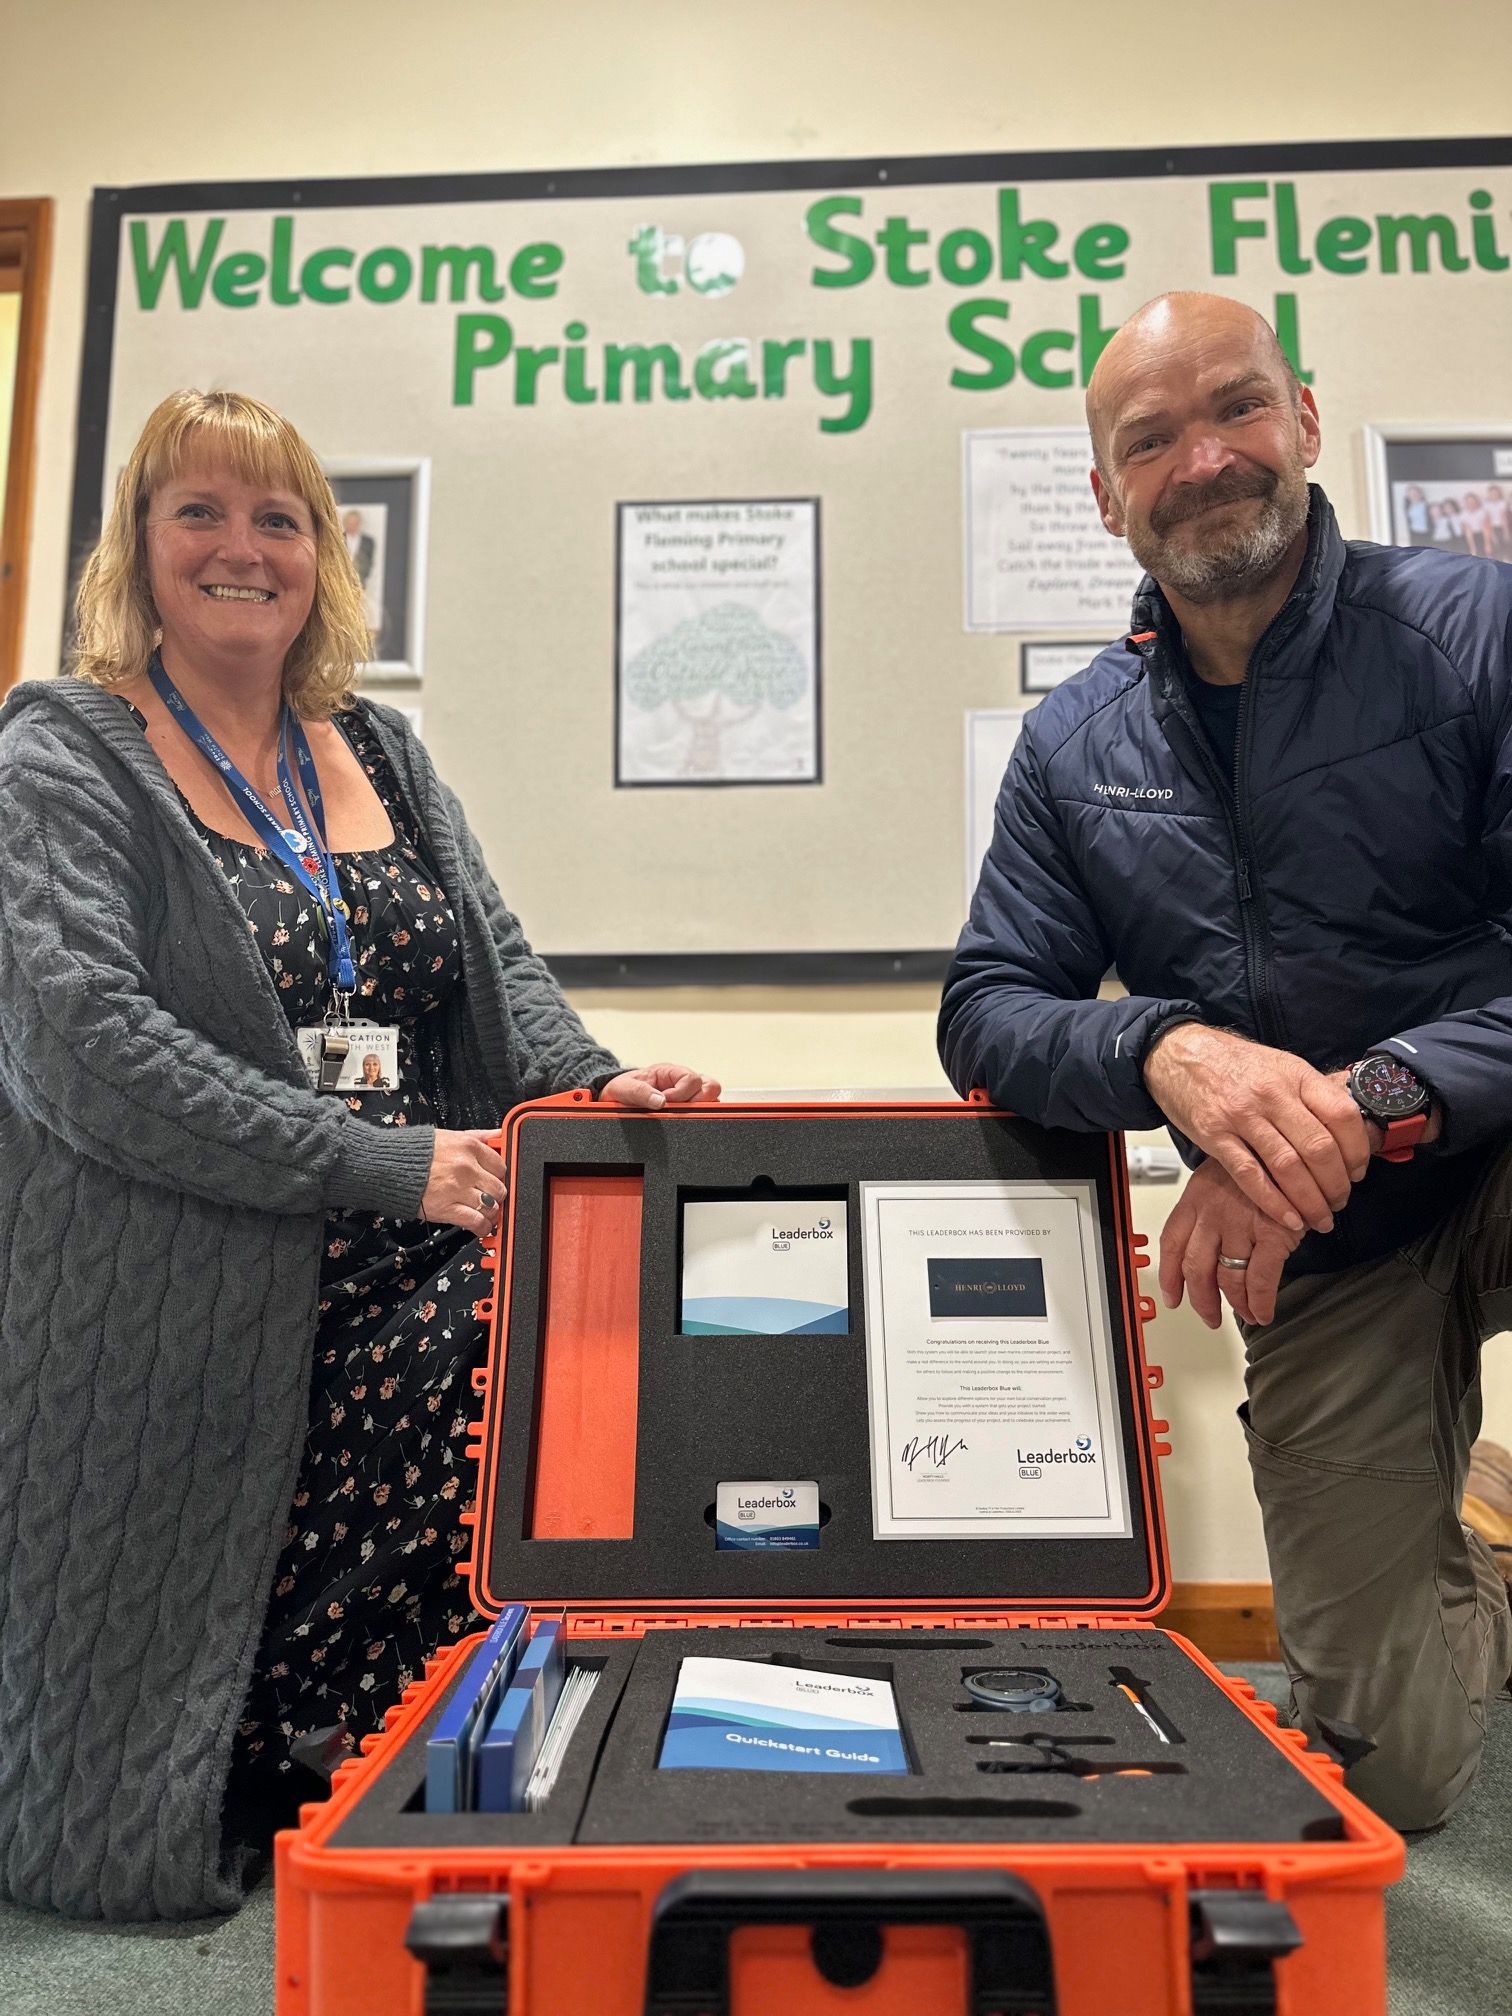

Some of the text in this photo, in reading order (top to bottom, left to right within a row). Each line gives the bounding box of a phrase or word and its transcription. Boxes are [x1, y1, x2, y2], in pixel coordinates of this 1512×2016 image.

[128, 180, 1511, 311] Welcome to Stoke Flemi
[451, 293, 1314, 434] Primary Schl
[282, 777, 297, 807] SCHOOL
[242, 786, 283, 834] MARY SCHOOL
[292, 806, 309, 836] PRIMARY
[349, 1034, 390, 1042] CATION
[772, 1228, 834, 1240] Leaderbox
[955, 1282, 1026, 1292] HENRI LLOYD
[1017, 1448, 1096, 1464] Leaderbox
[1021, 1469, 1040, 1477] BLUE
[738, 1497, 796, 1509] Leaderbox
[795, 1680, 875, 1697] Leaderbox
[725, 1732, 881, 1764] Quickstart Guide
